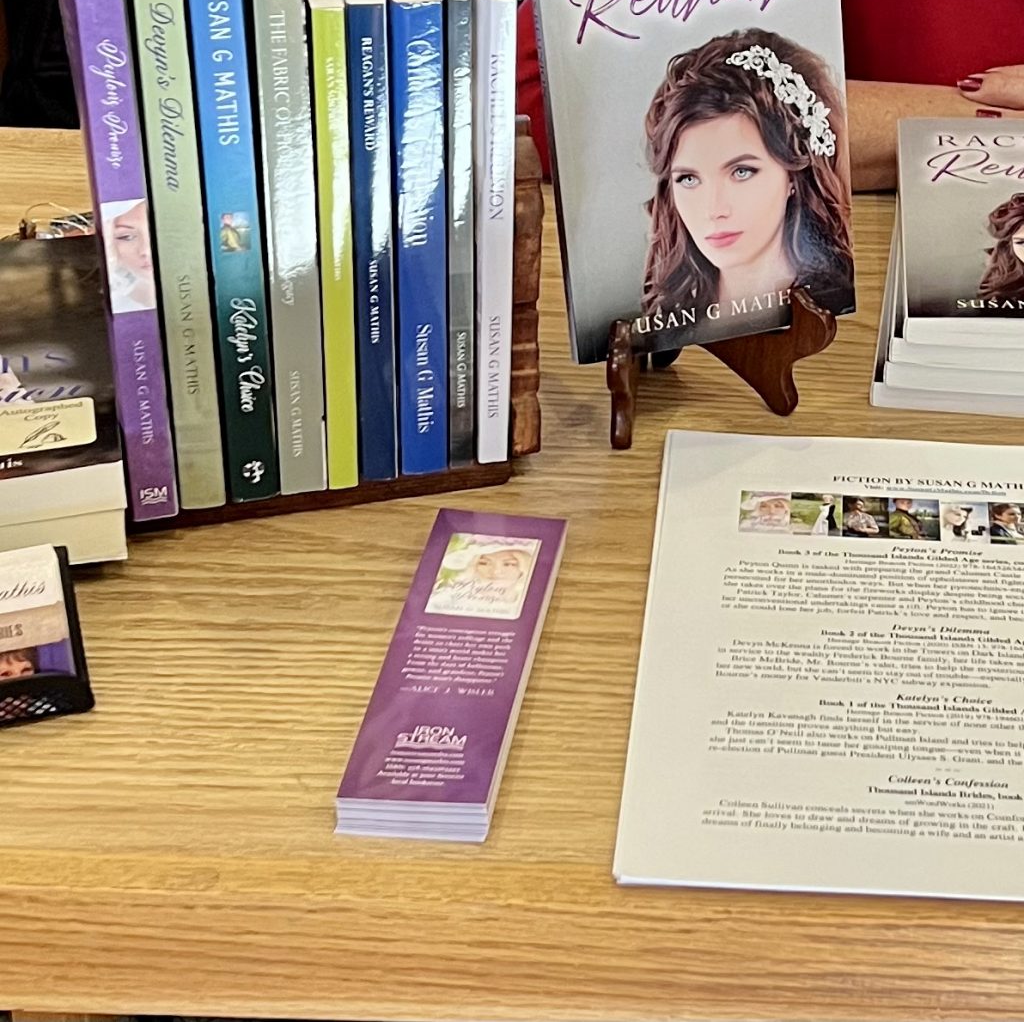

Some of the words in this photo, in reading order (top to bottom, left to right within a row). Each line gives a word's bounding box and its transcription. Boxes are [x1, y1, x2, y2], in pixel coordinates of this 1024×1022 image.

[144, 2, 175, 90] Devyn's
[268, 10, 286, 43] THE
[212, 49, 232, 62] G
[271, 48, 290, 103] FABRIC
[361, 37, 374, 96] REAGAN'S
[213, 72, 240, 146] MATHIS
[363, 99, 378, 152] REWARD
[158, 97, 183, 192] Dilemma
[369, 259, 380, 293] SUSAN
[178, 275, 192, 323] SUSAN
[370, 296, 379, 304] G
[636, 307, 696, 334] USAN
[706, 304, 720, 319] G
[731, 288, 792, 316] MATH
[182, 330, 194, 339] G
[226, 297, 258, 363] Katelyn's
[370, 306, 380, 344] MATHIS
[415, 323, 433, 367] Susan
[488, 316, 501, 357] SUSAN
[133, 339, 147, 381] SUSAN
[183, 342, 199, 395] MATHIS
[417, 370, 433, 382] G
[488, 360, 500, 370] G
[1, 401, 84, 416] Autographed
[138, 386, 149, 396] G
[238, 365, 265, 413] Choice
[416, 385, 436, 434] Mathis
[488, 372, 501, 420] MATHIS
[23, 412, 59, 422] Copy
[139, 400, 155, 446] MATHIS
[140, 486, 168, 499] ISM
[833, 475, 893, 484] FICTION
[895, 477, 912, 485] BY
[917, 479, 963, 488] SUSAN
[892, 624, 936, 633] Devyn's
[940, 626, 990, 635] Dilemma
[896, 694, 948, 703] Katelyn's
[953, 696, 993, 705] Choice
[888, 775, 941, 786] Colleen's
[945, 778, 1009, 789] Confession
